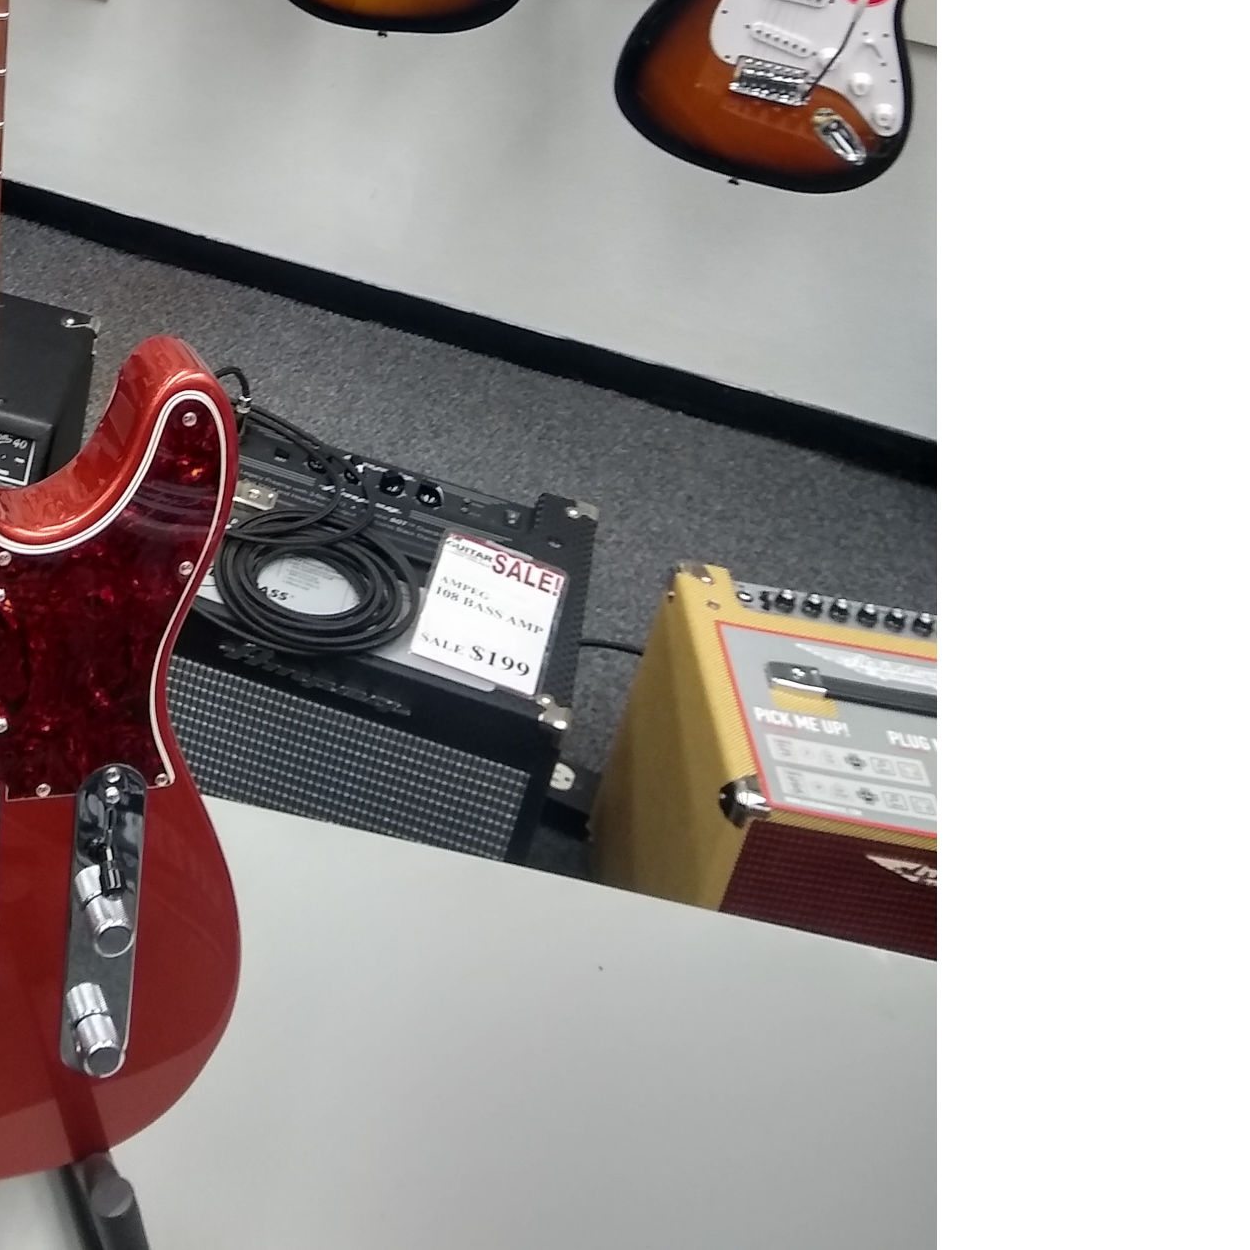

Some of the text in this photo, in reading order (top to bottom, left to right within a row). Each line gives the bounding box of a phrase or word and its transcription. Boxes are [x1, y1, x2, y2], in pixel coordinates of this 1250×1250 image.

[12, 438, 28, 450] 40
[440, 576, 489, 600] AMPEG
[492, 554, 562, 597] SALE!
[436, 586, 543, 634] 108 BASS AMP
[419, 631, 530, 677] SALE $199
[753, 707, 850, 737] PICK ME UP!
[886, 730, 931, 750] PLUG
